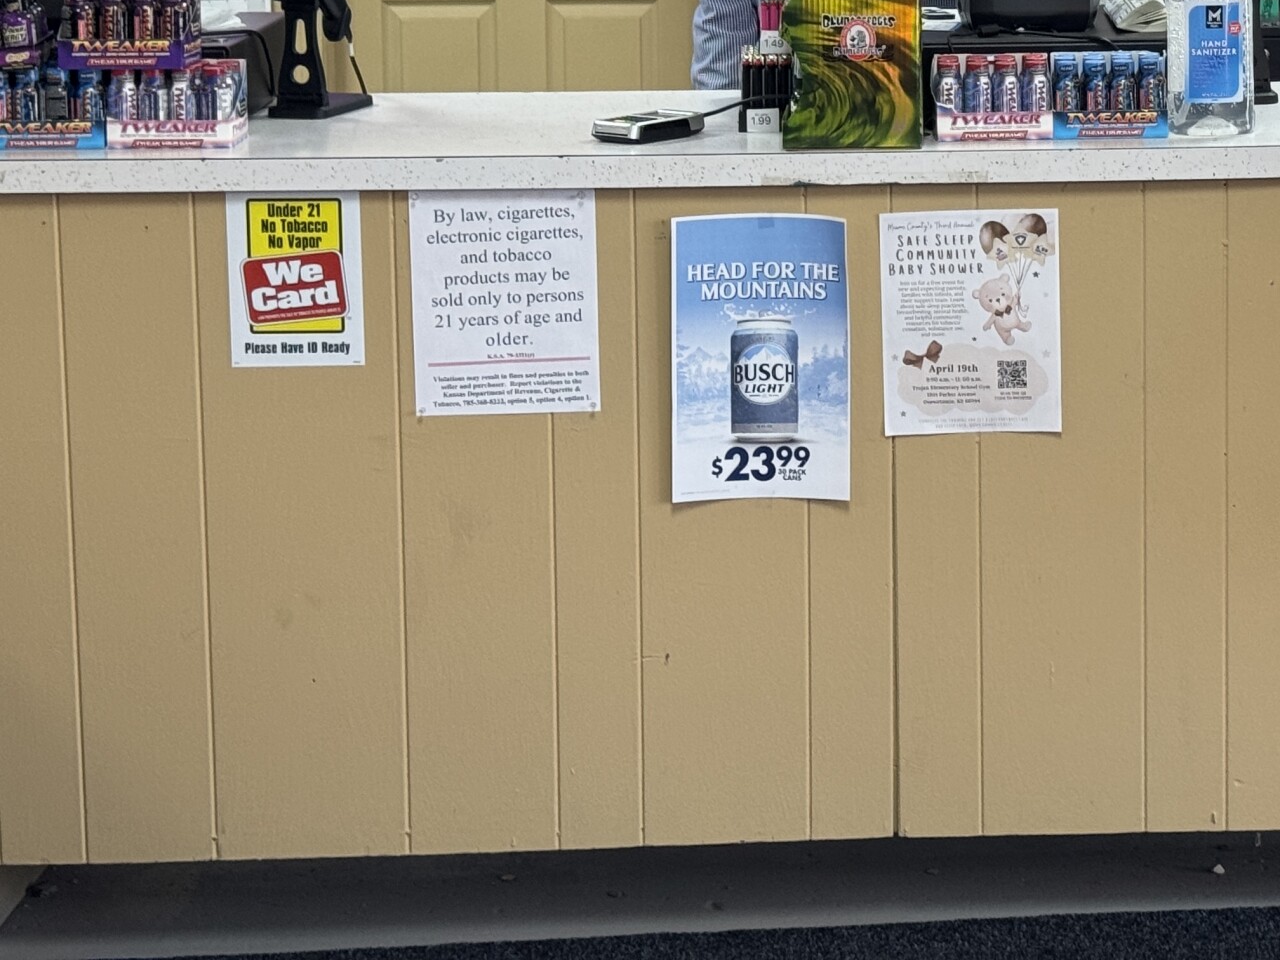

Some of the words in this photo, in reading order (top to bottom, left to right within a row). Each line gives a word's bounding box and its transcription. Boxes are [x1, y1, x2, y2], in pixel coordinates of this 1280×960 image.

[1208, 8, 1221, 21] M
[72, 40, 169, 52] TWEAKER
[763, 40, 784, 48] 1.49
[1191, 48, 1237, 56] SANITIZER
[751, 116, 771, 125] 1.99
[951, 114, 1041, 126] TWEAKER
[1067, 112, 1157, 123] TWEAKER
[267, 204, 303, 217] Under
[308, 203, 321, 217] 21
[433, 209, 455, 226] By
[461, 208, 493, 223] law,
[497, 206, 575, 223] cigarettes,
[261, 219, 276, 233] No
[281, 219, 328, 233] Tobacco
[934, 221, 951, 230] Third
[268, 235, 283, 249] No
[288, 235, 322, 250] Vapor
[426, 227, 501, 244] electronic
[506, 227, 584, 244] cigarettes,
[897, 234, 928, 248] SAFE
[935, 234, 974, 246] SLEEP
[460, 249, 487, 264] and
[493, 248, 552, 262] tobacco
[896, 248, 977, 262] COMMUNITY
[262, 260, 324, 286] We
[687, 262, 746, 283] HEAD
[752, 261, 796, 280] FOR
[801, 262, 841, 282] THE
[889, 263, 923, 276] BABY
[930, 261, 984, 275] SHOWER
[444, 270, 510, 289] products
[515, 271, 547, 285] may
[552, 267, 570, 280] be
[251, 280, 340, 311] Card
[700, 281, 828, 301] MOUNTAINS
[431, 292, 463, 307] sold
[468, 291, 501, 308] only
[507, 291, 521, 304] to
[526, 290, 584, 306] persons
[434, 314, 451, 328] 21
[459, 315, 499, 331] years
[504, 310, 522, 325] of
[524, 313, 551, 327] age
[555, 308, 582, 322] and
[485, 332, 533, 346] older.
[245, 342, 277, 354] Please
[281, 342, 304, 354] Have
[307, 342, 318, 354] ID
[321, 341, 350, 355] Ready
[538, 371, 566, 379] penalties
[734, 363, 795, 385] BUSCH
[929, 364, 954, 375] April
[957, 364, 979, 373] 19th
[744, 384, 784, 394] LIGHT
[778, 468, 787, 476] 30
[789, 468, 807, 476] PACK
